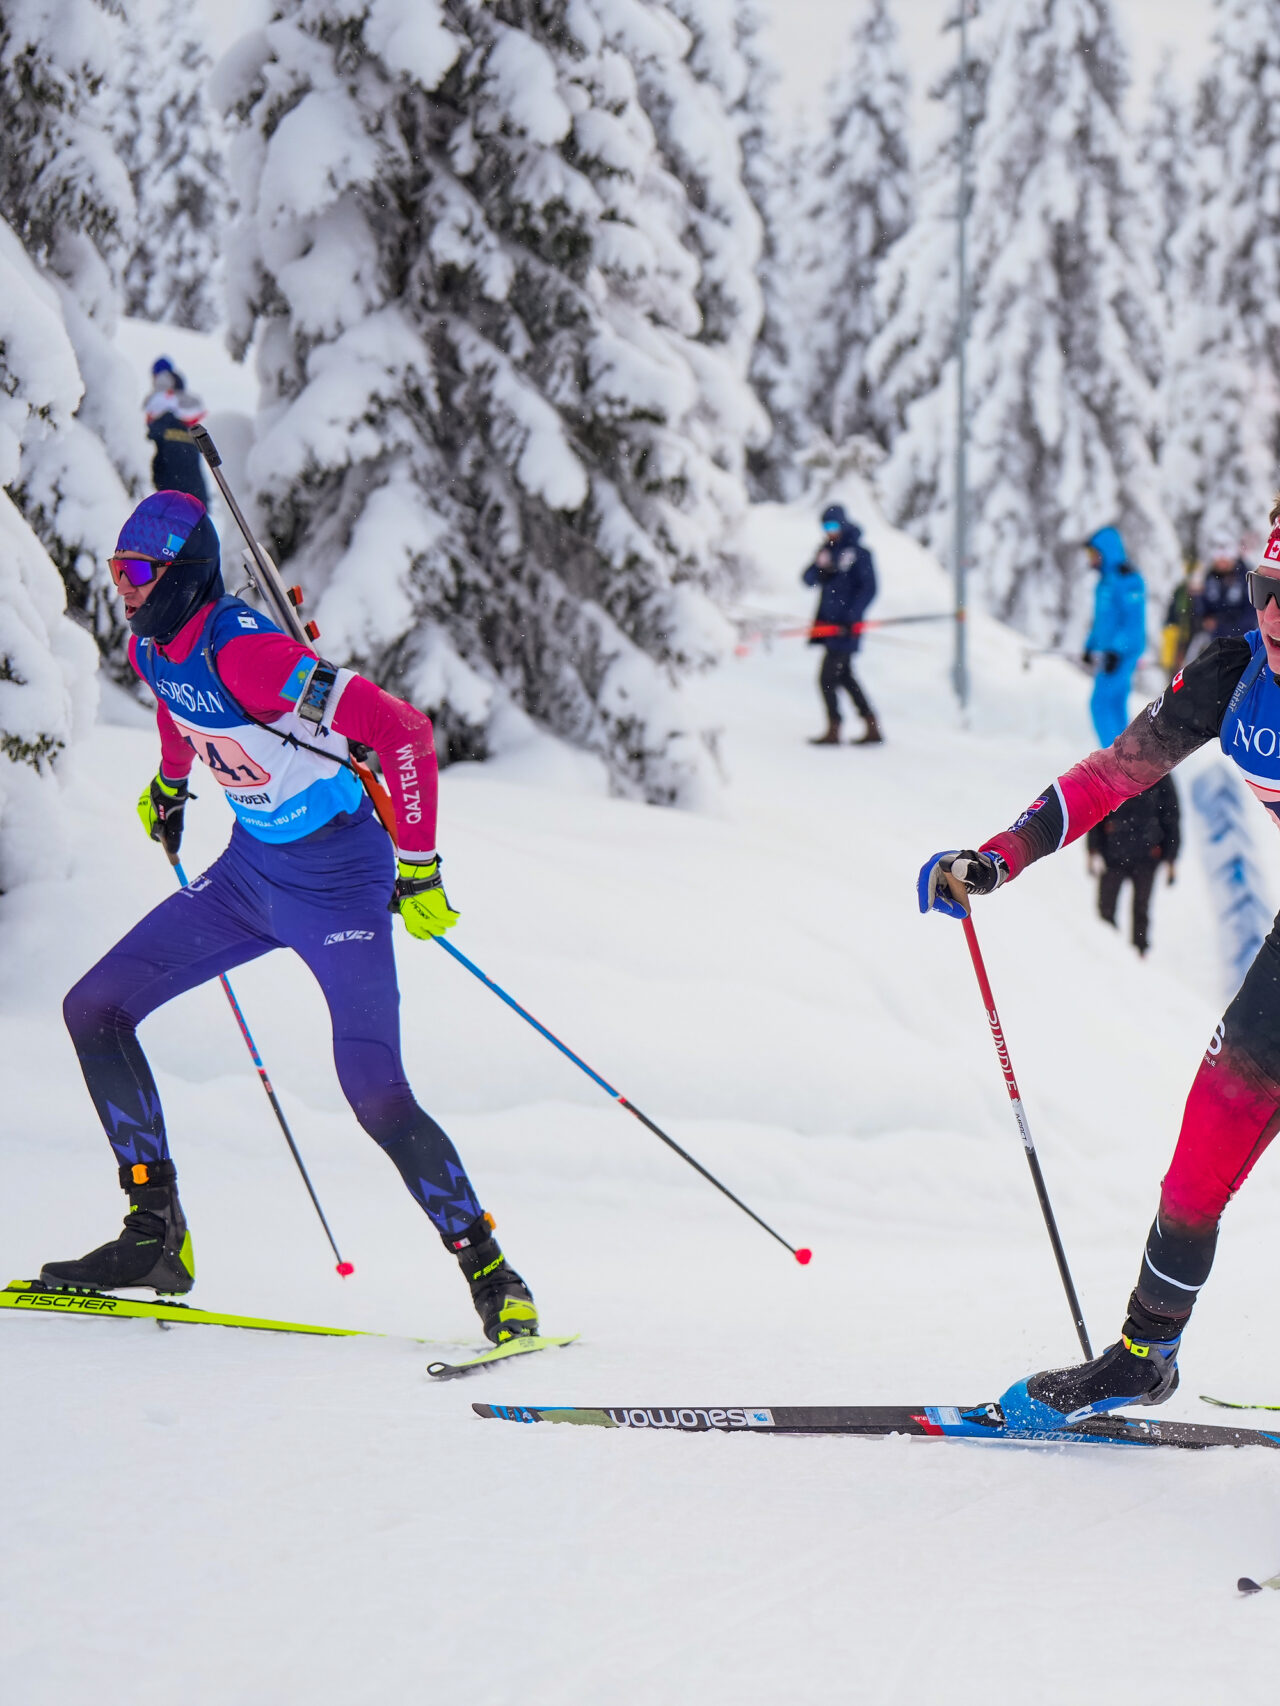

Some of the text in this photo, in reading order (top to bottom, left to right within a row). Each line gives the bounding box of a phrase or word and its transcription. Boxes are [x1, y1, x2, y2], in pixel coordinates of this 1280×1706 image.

[162, 547, 178, 558] QA
[396, 743, 423, 825] QAZ TEAM
[290, 805, 308, 820] APP
[14, 1294, 117, 1311] FISCHER
